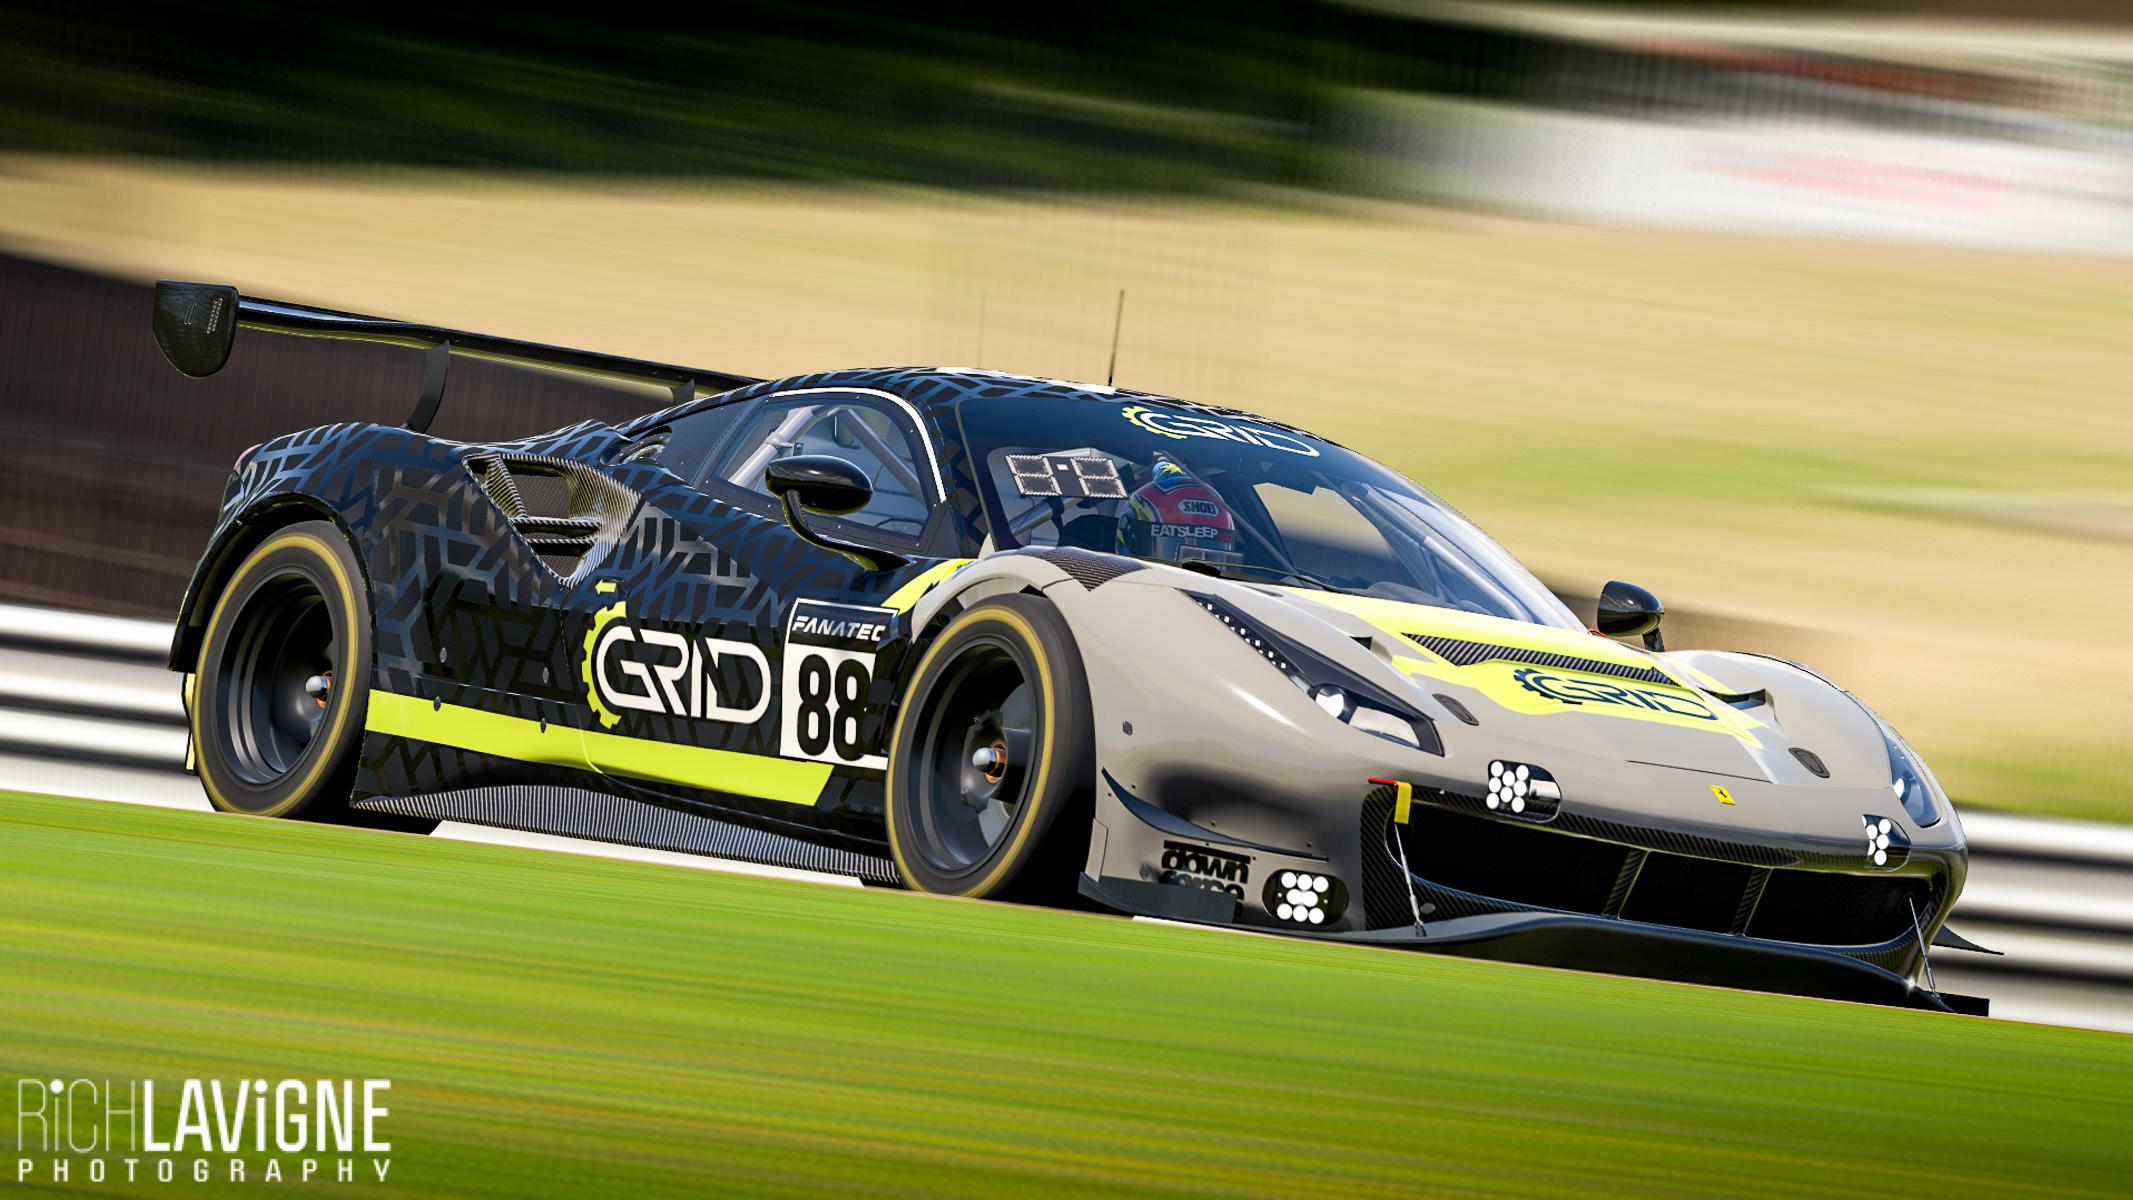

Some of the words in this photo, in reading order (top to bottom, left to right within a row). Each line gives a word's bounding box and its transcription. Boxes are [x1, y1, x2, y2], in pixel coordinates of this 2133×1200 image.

[1139, 412, 1320, 457] GRID
[792, 615, 886, 642] FANATEC
[597, 625, 771, 724] GRID
[797, 654, 873, 761] 88
[1532, 675, 1719, 720] GRID
[1162, 847, 1249, 884] down
